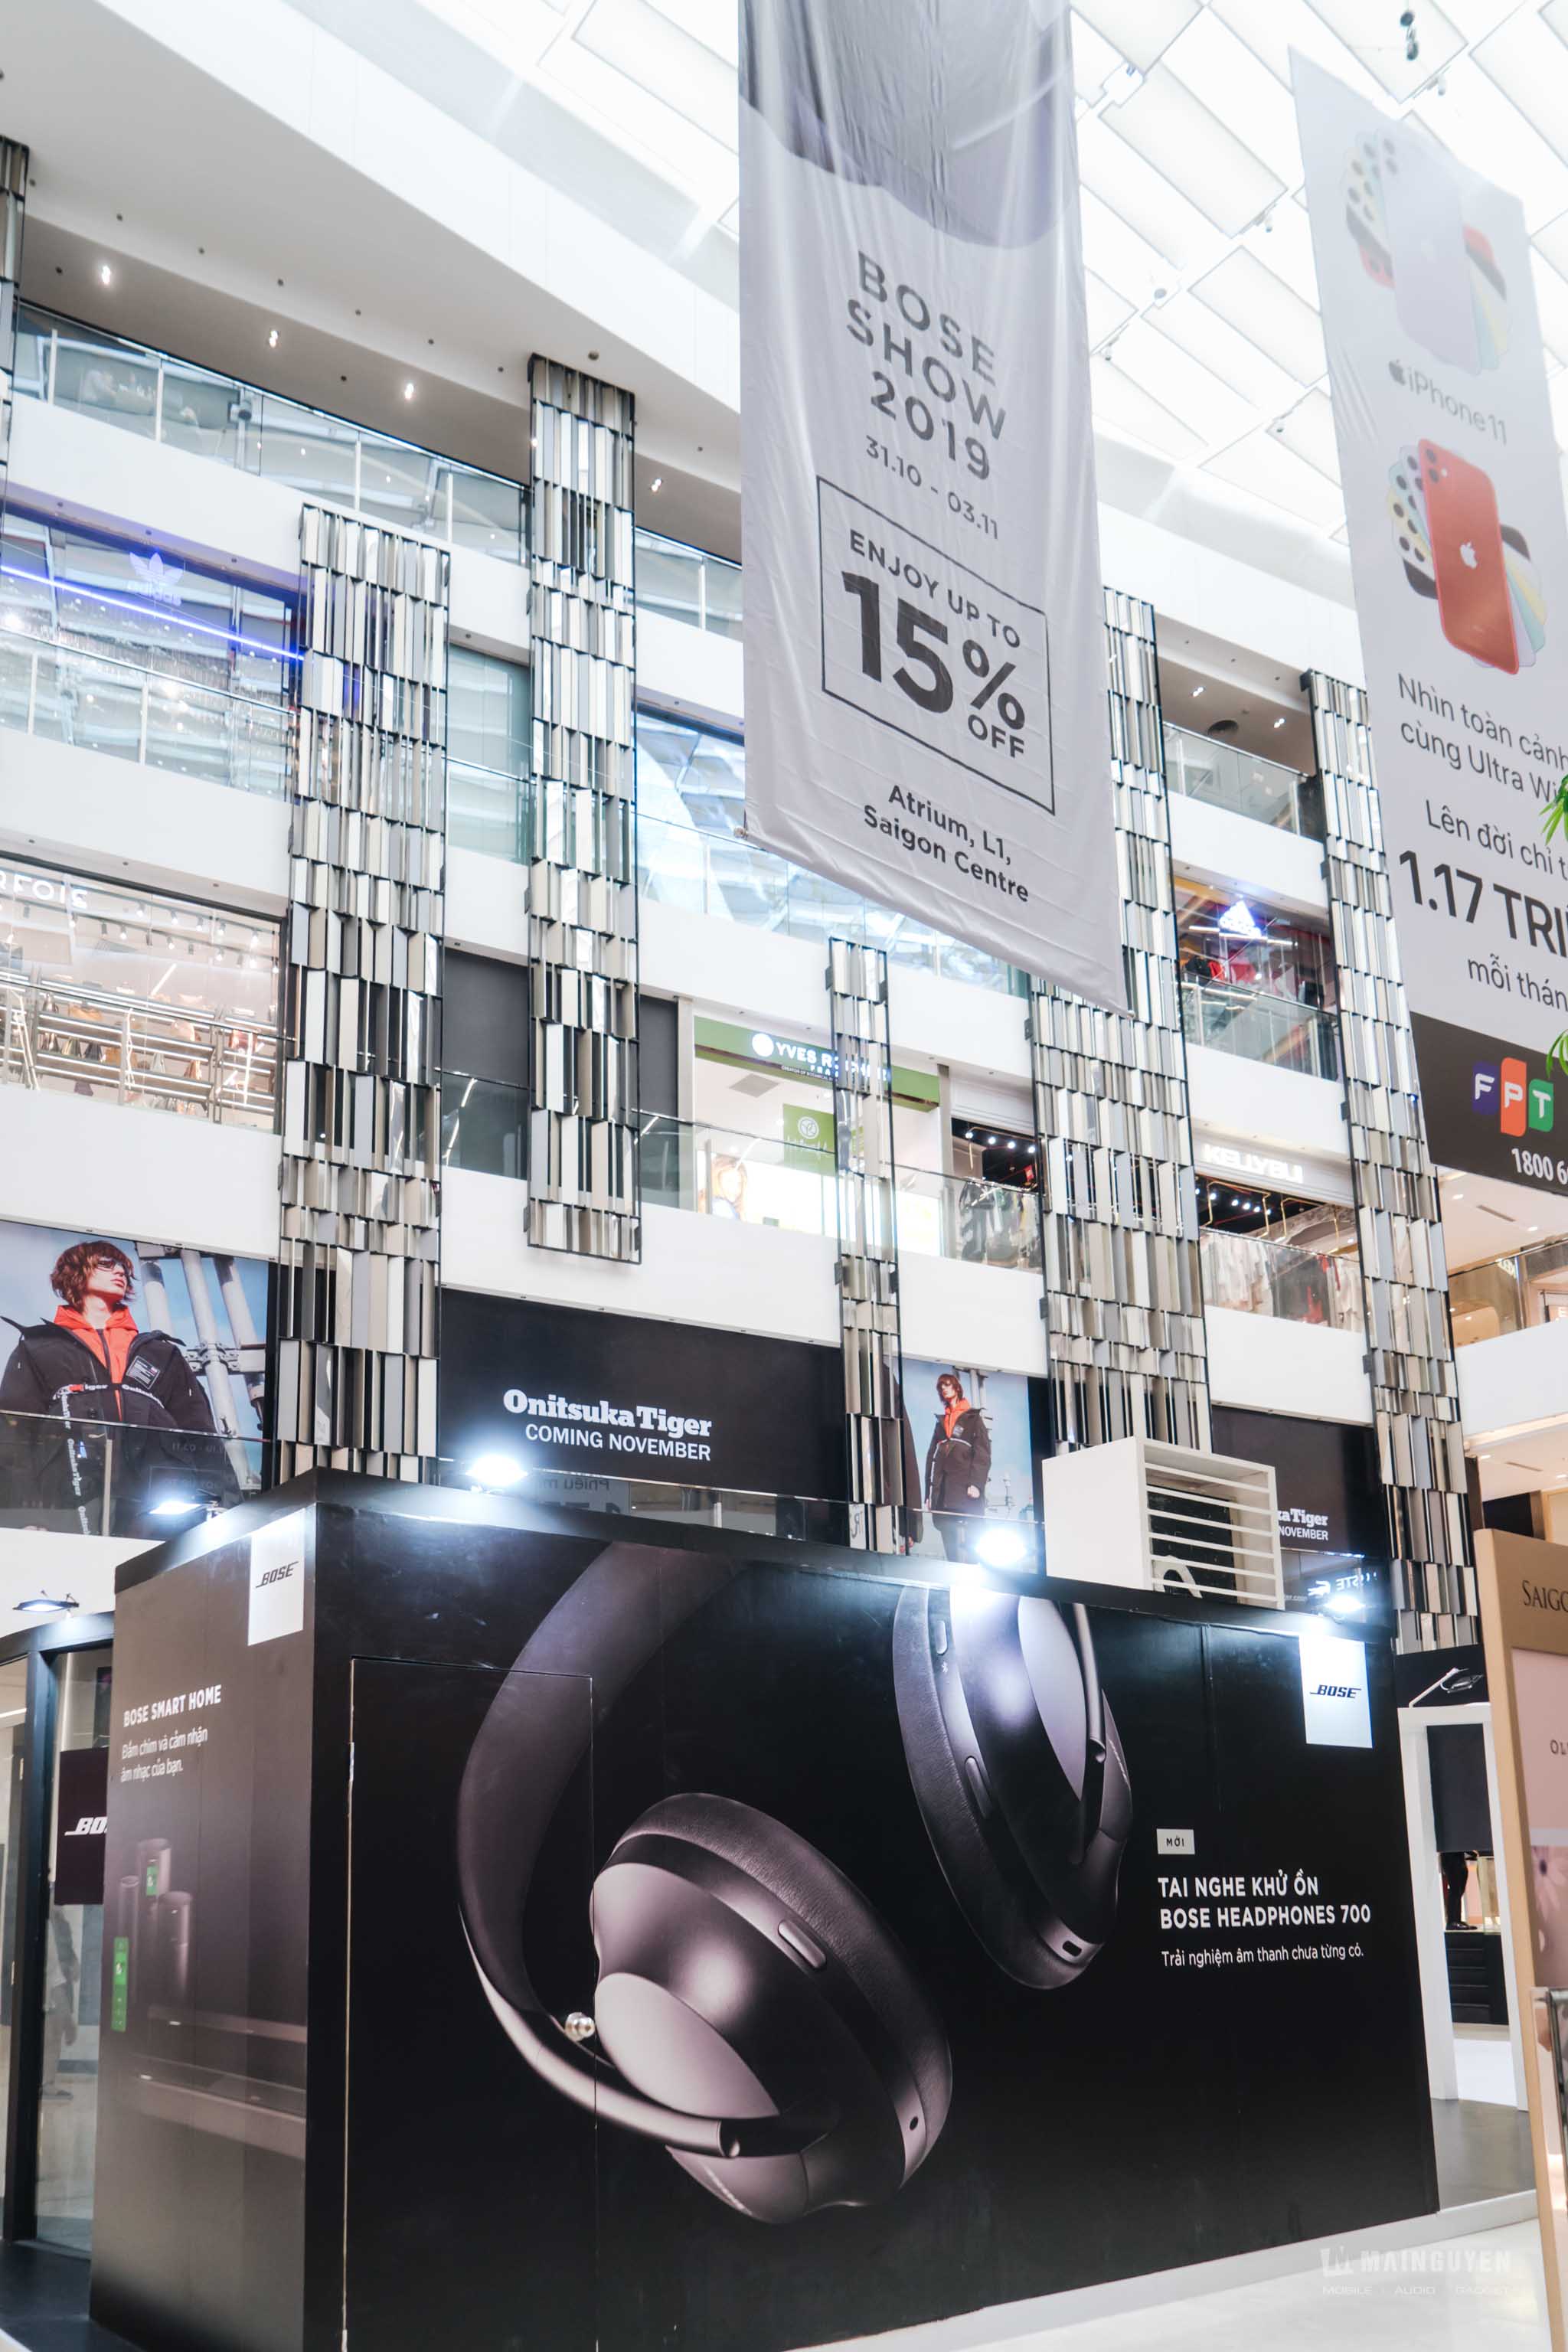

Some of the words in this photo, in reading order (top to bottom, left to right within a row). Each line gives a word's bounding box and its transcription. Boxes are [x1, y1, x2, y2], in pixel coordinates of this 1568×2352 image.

[858, 250, 995, 387] BOSE
[846, 299, 1006, 439] SHOW
[871, 371, 990, 480] 2019
[866, 435, 922, 487] 31.10
[948, 492, 998, 539] 03.11
[849, 529, 939, 599] ENJOY
[948, 589, 980, 621] UP
[987, 613, 1020, 648] TO
[841, 570, 1025, 730] 15%
[1398, 673, 1455, 722] Nhìn
[1460, 704, 1512, 748] toàn
[968, 714, 1024, 758] OFF
[1400, 720, 1462, 770] cùng
[1468, 744, 1524, 792] Ultra
[888, 785, 975, 848] Atrium,
[983, 830, 1011, 865] L1,
[1426, 799, 1471, 841] Lên
[1478, 823, 1513, 859] đời
[1521, 842, 1553, 874] chỉ
[864, 805, 946, 863] Saigon
[954, 851, 1029, 902] Centre
[1399, 850, 1483, 923] 1.17
[1493, 883, 1568, 958] TRI
[1468, 953, 1511, 992] mỗi
[776, 1042, 817, 1063] YVES
[1475, 1073, 1551, 1119] FPT
[1511, 1148, 1553, 1181] 1800
[1557, 1160, 1568, 1185] 6
[525, 1423, 603, 1449] COMING
[609, 1433, 711, 1461] NOVEMBER
[1279, 1526, 1329, 1541] NOVEMBER
[256, 1561, 299, 1589] BOSE
[123, 1704, 149, 1727] BOSE
[151, 1694, 186, 1720] SMART
[188, 1684, 222, 1711] HOME
[1310, 1684, 1362, 1699] BOSE
[1550, 1740, 1568, 1755] OL
[64, 1816, 107, 1836] BO
[1158, 1877, 1187, 1898] TAI
[1195, 1877, 1246, 1897] NGHE
[1252, 1869, 1288, 1896] KHỬ
[1294, 1868, 1318, 1896] ỒN
[1160, 1907, 1210, 1929] BOSE
[1217, 1905, 1335, 1928] HEADPHONES
[1340, 1904, 1371, 1923] 700
[1161, 1949, 1185, 1967] Trải
[1189, 1949, 1233, 1968] nghiệm
[1236, 1948, 1254, 1963] âm
[1257, 1945, 1289, 1962] thanh
[1292, 1945, 1318, 1960] chưa
[1321, 1944, 1346, 1960] từng
